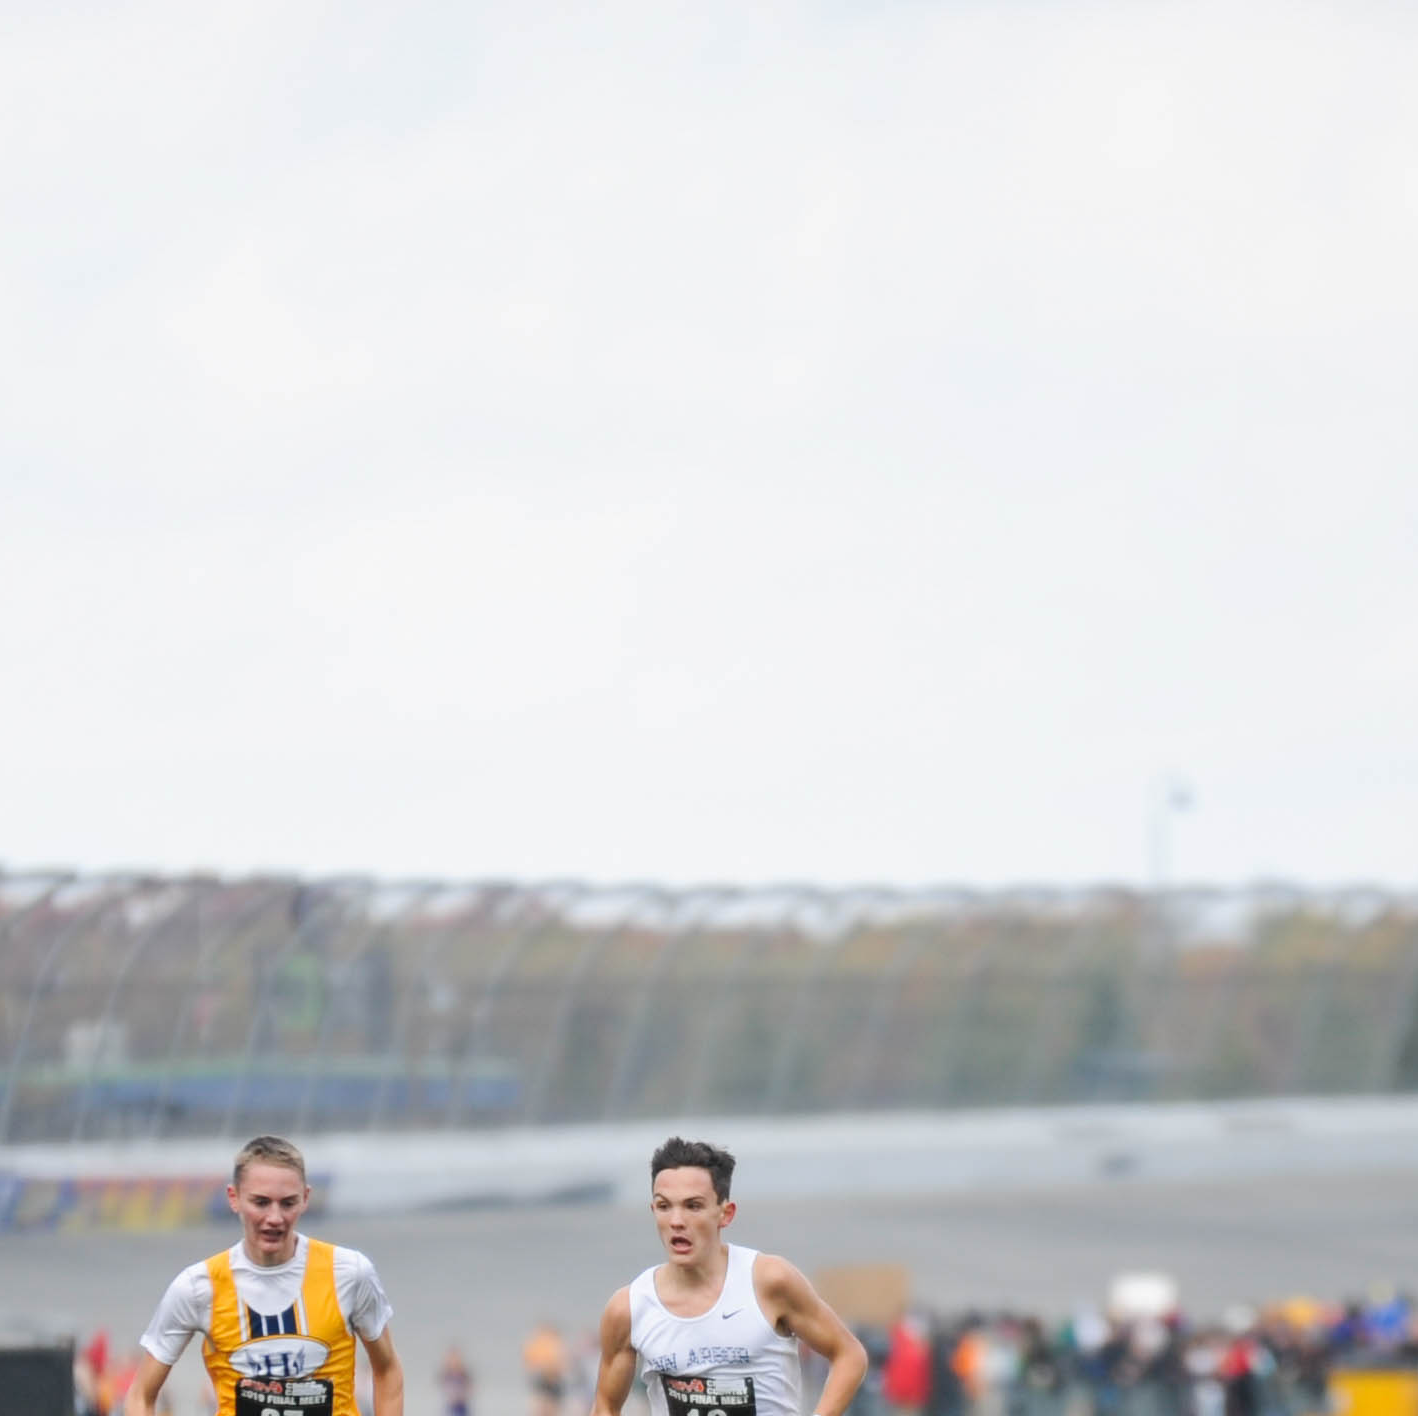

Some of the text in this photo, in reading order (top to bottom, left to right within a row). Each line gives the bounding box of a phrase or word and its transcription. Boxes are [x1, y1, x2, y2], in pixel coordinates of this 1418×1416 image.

[240, 1389, 327, 1405] 2019 FINAL MEET
[667, 1387, 749, 1405] 2019 FINAL MEET
